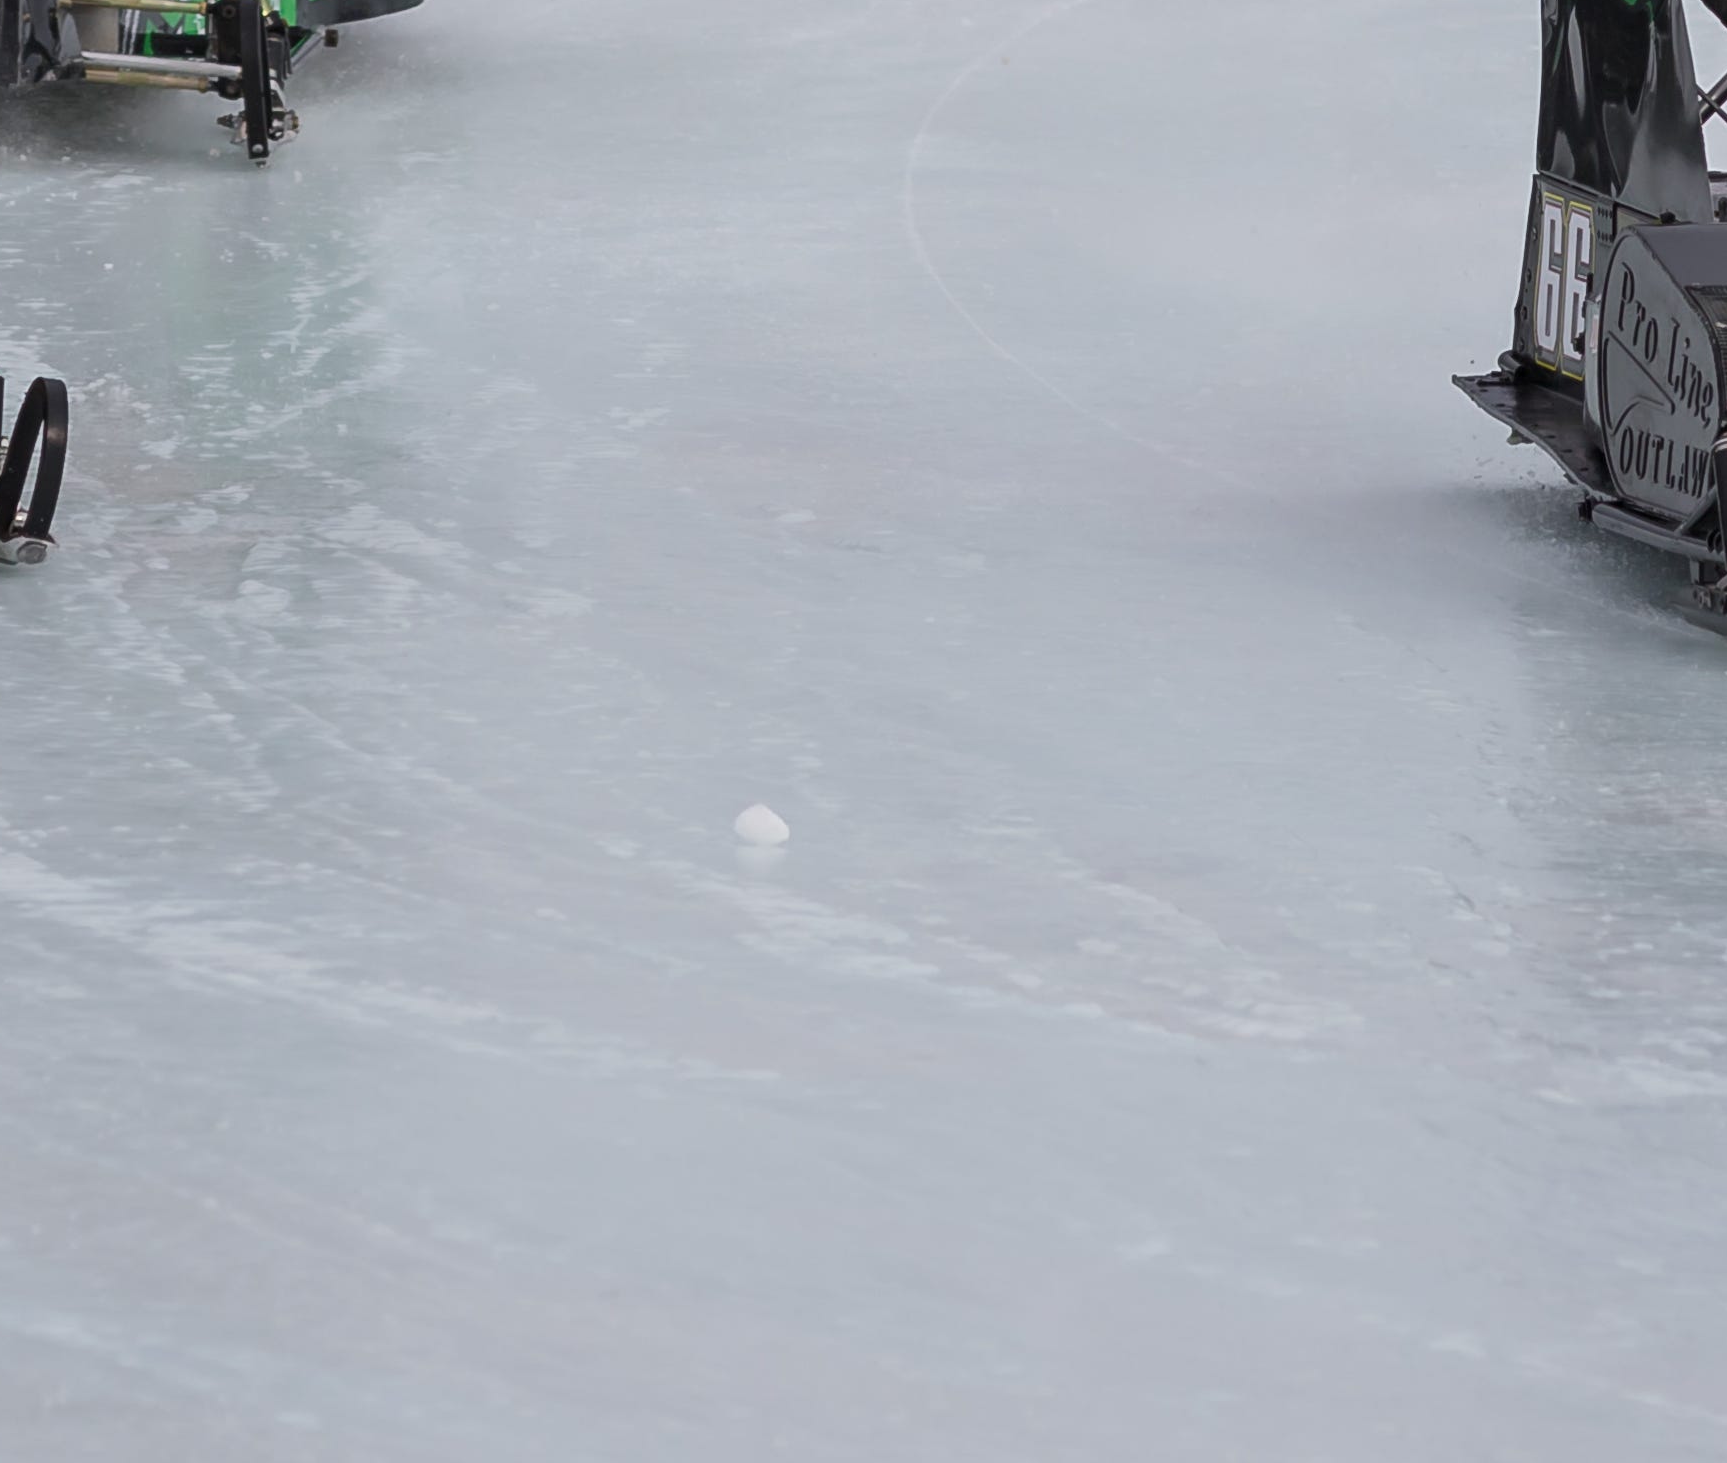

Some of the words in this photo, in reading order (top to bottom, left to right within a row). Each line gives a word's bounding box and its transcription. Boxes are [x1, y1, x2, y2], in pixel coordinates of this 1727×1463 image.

[1535, 196, 1593, 373] 66
[1618, 262, 1659, 364] Pro
[1667, 317, 1715, 430] Line
[1619, 425, 1709, 499] OUTLAW
